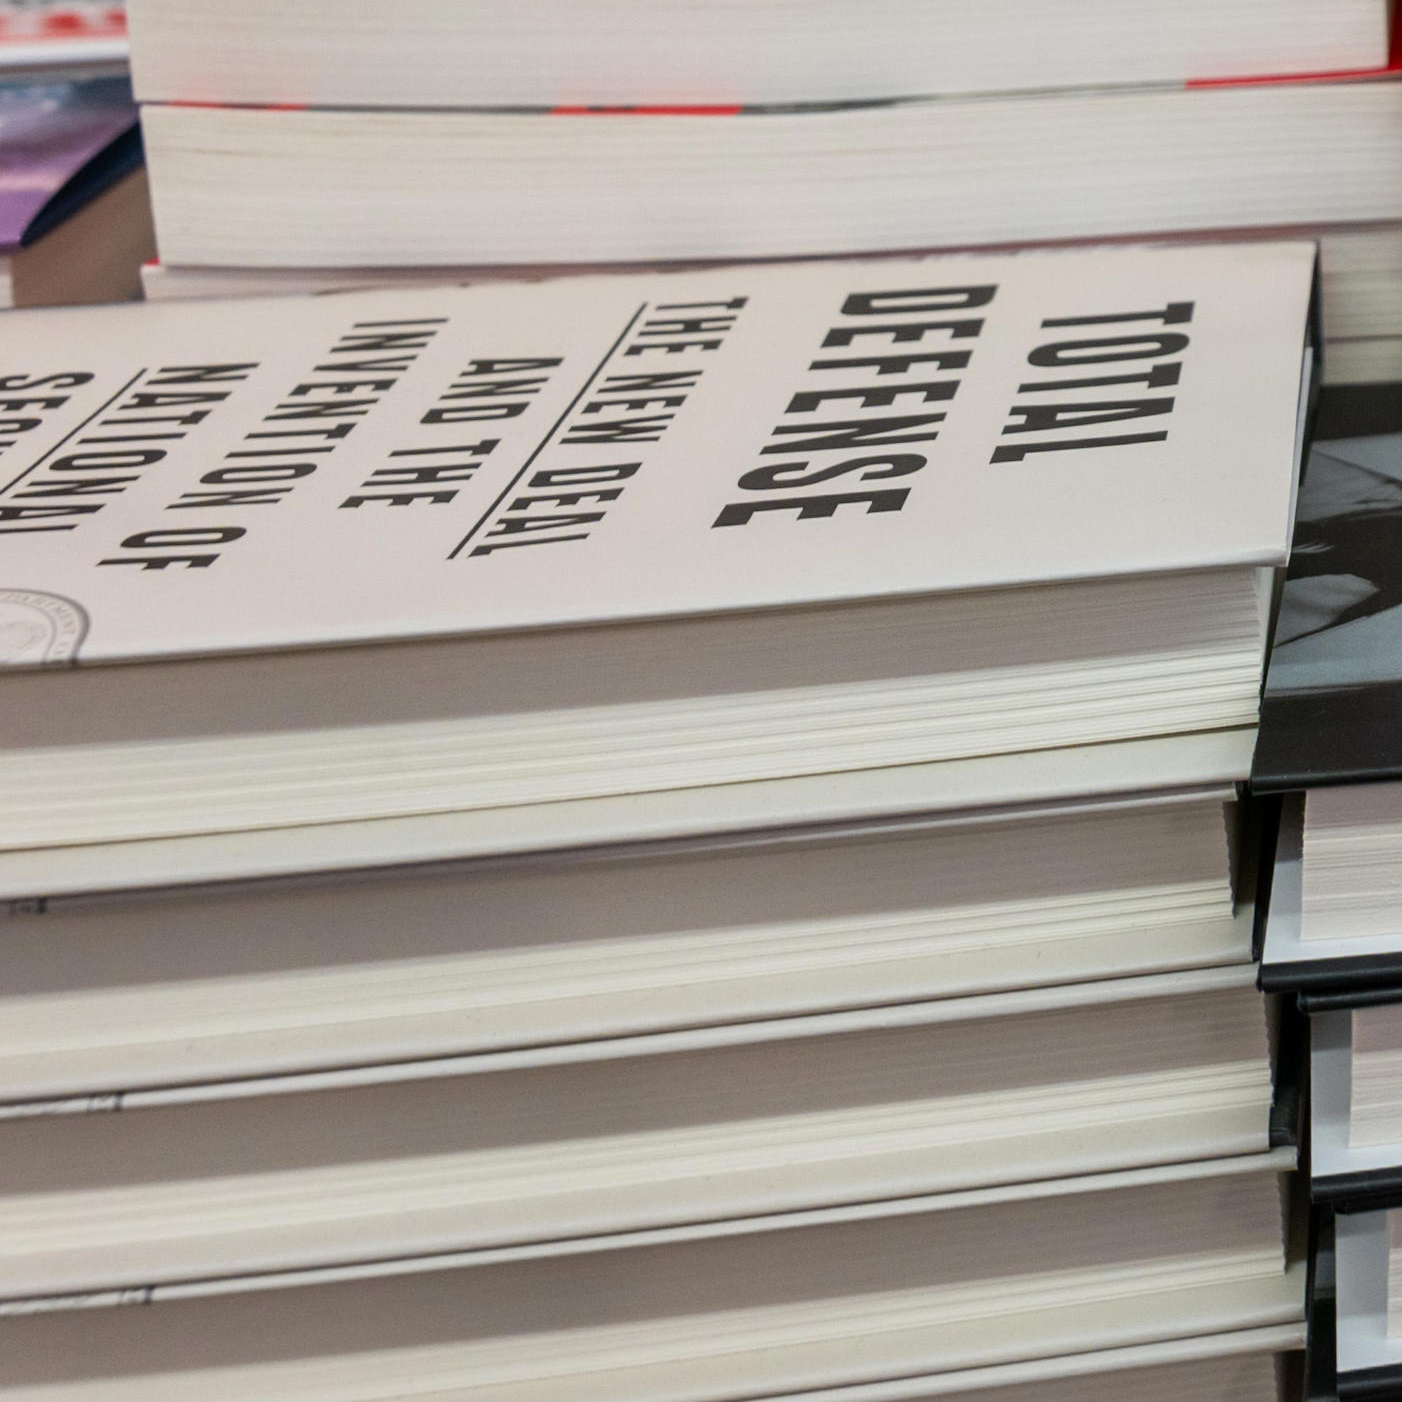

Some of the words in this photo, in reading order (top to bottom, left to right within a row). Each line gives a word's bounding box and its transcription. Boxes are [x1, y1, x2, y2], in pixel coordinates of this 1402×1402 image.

[622, 295, 750, 358] THE
[164, 315, 450, 511] INVENTION
[418, 356, 565, 426] AND
[558, 369, 704, 446] NEW
[709, 283, 999, 530] DEFENSE
[987, 300, 1196, 466] TOTAL
[337, 437, 502, 510] THE
[466, 460, 644, 559] DEAL
[95, 525, 248, 572] OF
